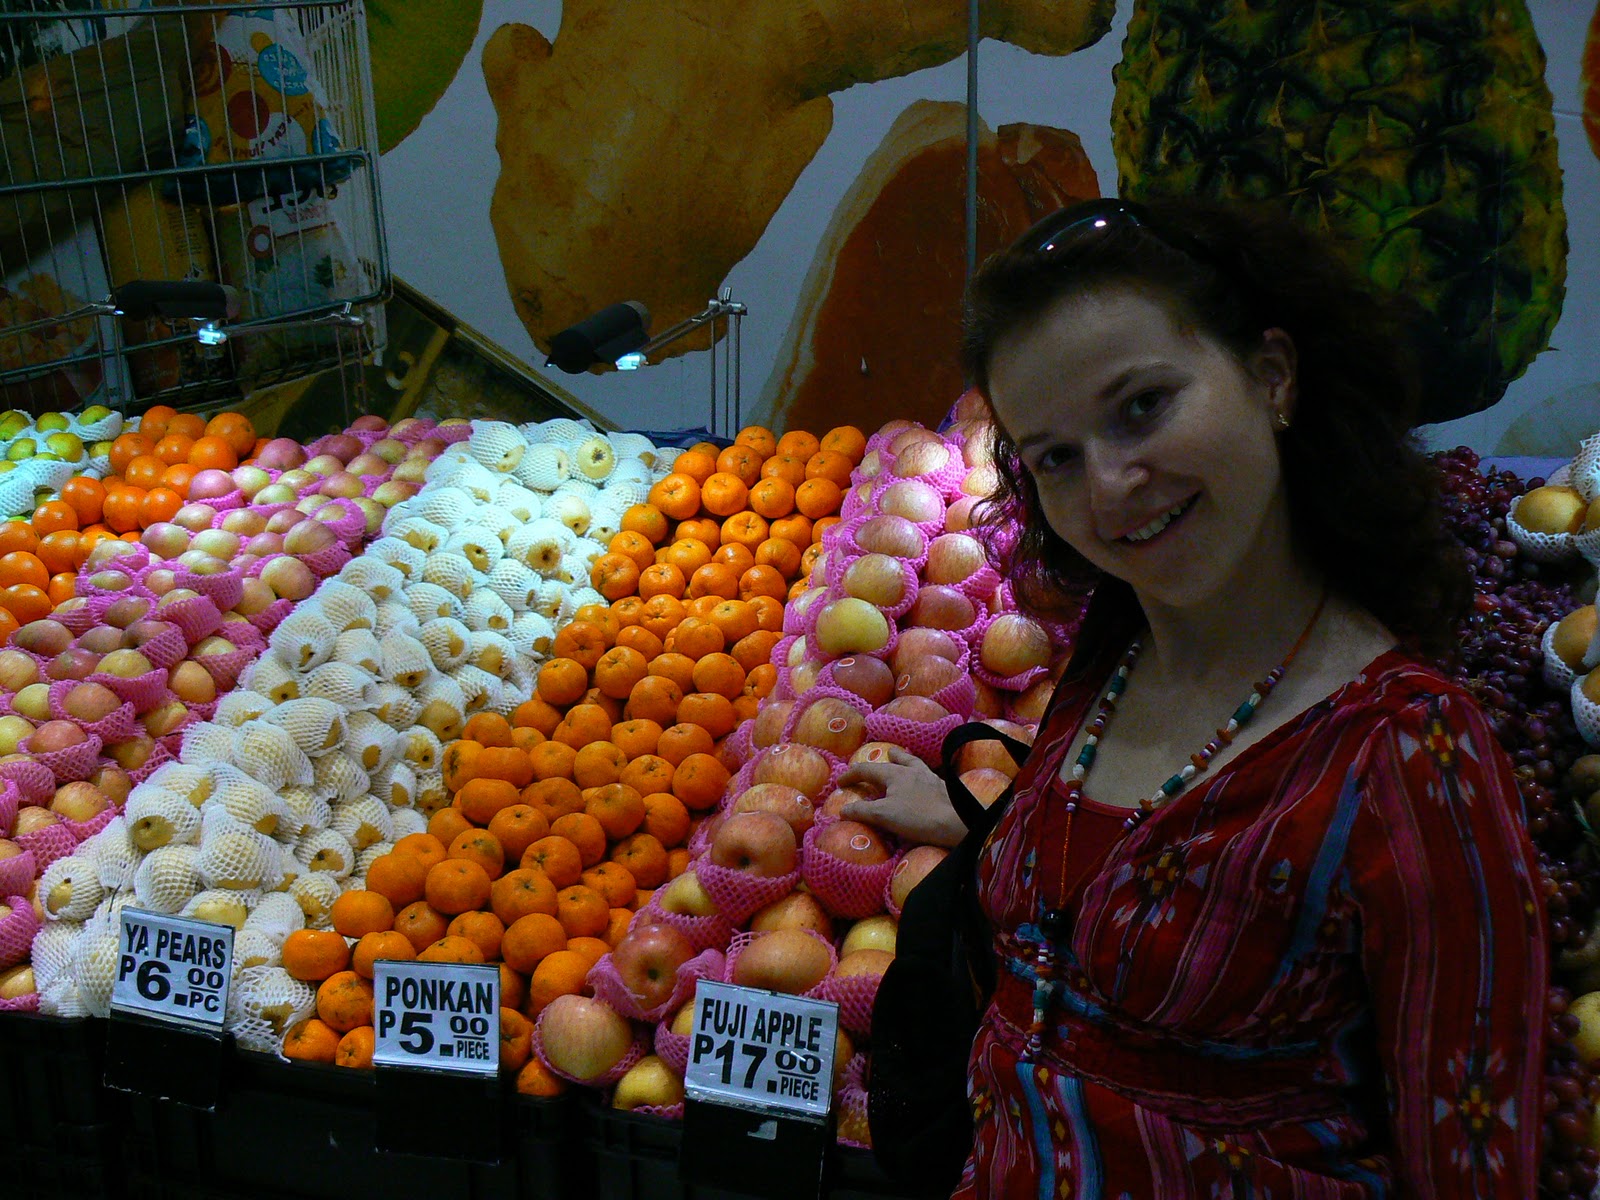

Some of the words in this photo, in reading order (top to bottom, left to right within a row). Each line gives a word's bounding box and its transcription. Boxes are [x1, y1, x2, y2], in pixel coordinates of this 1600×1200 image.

[125, 923, 149, 956] YA
[156, 929, 226, 969] PEARS
[189, 991, 220, 1012] PC
[386, 976, 493, 1015] PONKAN
[701, 998, 748, 1039] FUJI
[751, 1008, 822, 1052] APPLE
[457, 1040, 490, 1060] PIECE
[780, 1076, 820, 1101] PIECE
